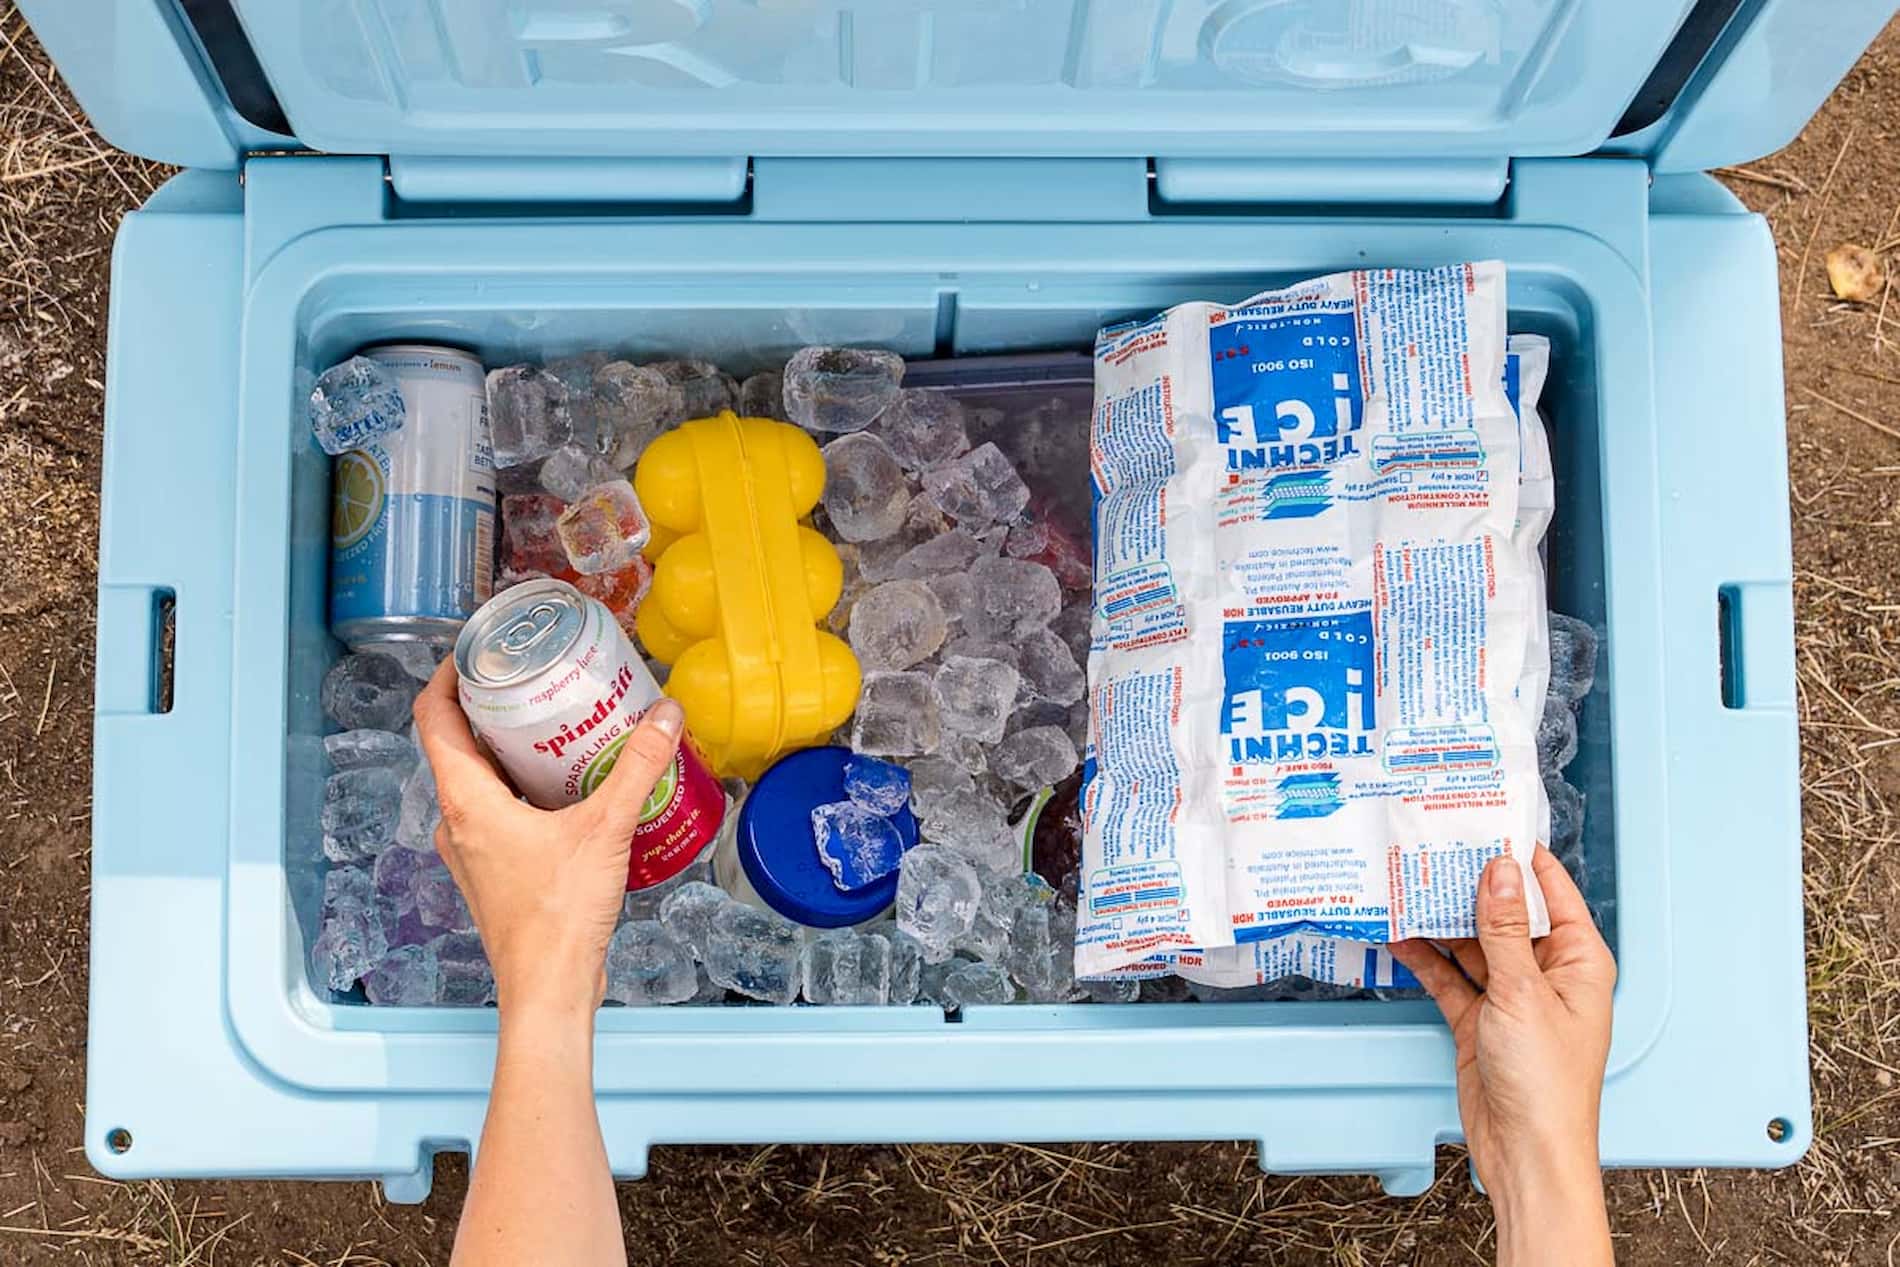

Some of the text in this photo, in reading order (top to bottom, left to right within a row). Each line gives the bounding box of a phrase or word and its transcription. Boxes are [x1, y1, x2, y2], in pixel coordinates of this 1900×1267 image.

[1209, 299, 1354, 324] HEAVY DUTY REUSABLE HDR
[1247, 318, 1321, 330] NON-TOXIC
[1302, 336, 1350, 346] COLD
[1252, 359, 1313, 373] ISO 9001
[1225, 435, 1360, 472] TECHNI
[1431, 472, 1445, 481] ply
[1454, 473, 1475, 481] HDR
[1388, 493, 1460, 503] CONSTRUCTION
[1463, 492, 1481, 500] PLY
[1407, 501, 1466, 509] MILLENNIUM
[1234, 561, 1275, 572] Australia
[1248, 569, 1343, 582] International Patents
[1260, 583, 1300, 593] Australia
[1256, 593, 1310, 604] APPROVED
[1223, 599, 1372, 618] HEAVY DUTY REUSABLE HDR
[1113, 632, 1167, 649] CONSTRUCTION
[1318, 631, 1367, 644] COLD
[1265, 650, 1328, 661] ISO 9001
[529, 645, 598, 705] raspberry lime
[533, 661, 633, 757] spindrift
[1229, 732, 1374, 765] TECHNI
[565, 725, 621, 796] SPARKLING
[1402, 791, 1477, 803] CONSTRUCTION
[636, 785, 685, 835] SQUEEZED
[1423, 799, 1507, 811] NEW MILLENNIUM
[1272, 886, 1314, 897] Australia
[1267, 897, 1324, 908] APPROVED
[1232, 906, 1389, 924] HEAVY DUTY REUSABLE HDR
[1179, 954, 1203, 967] HDR
[1112, 963, 1166, 972] PROVED
